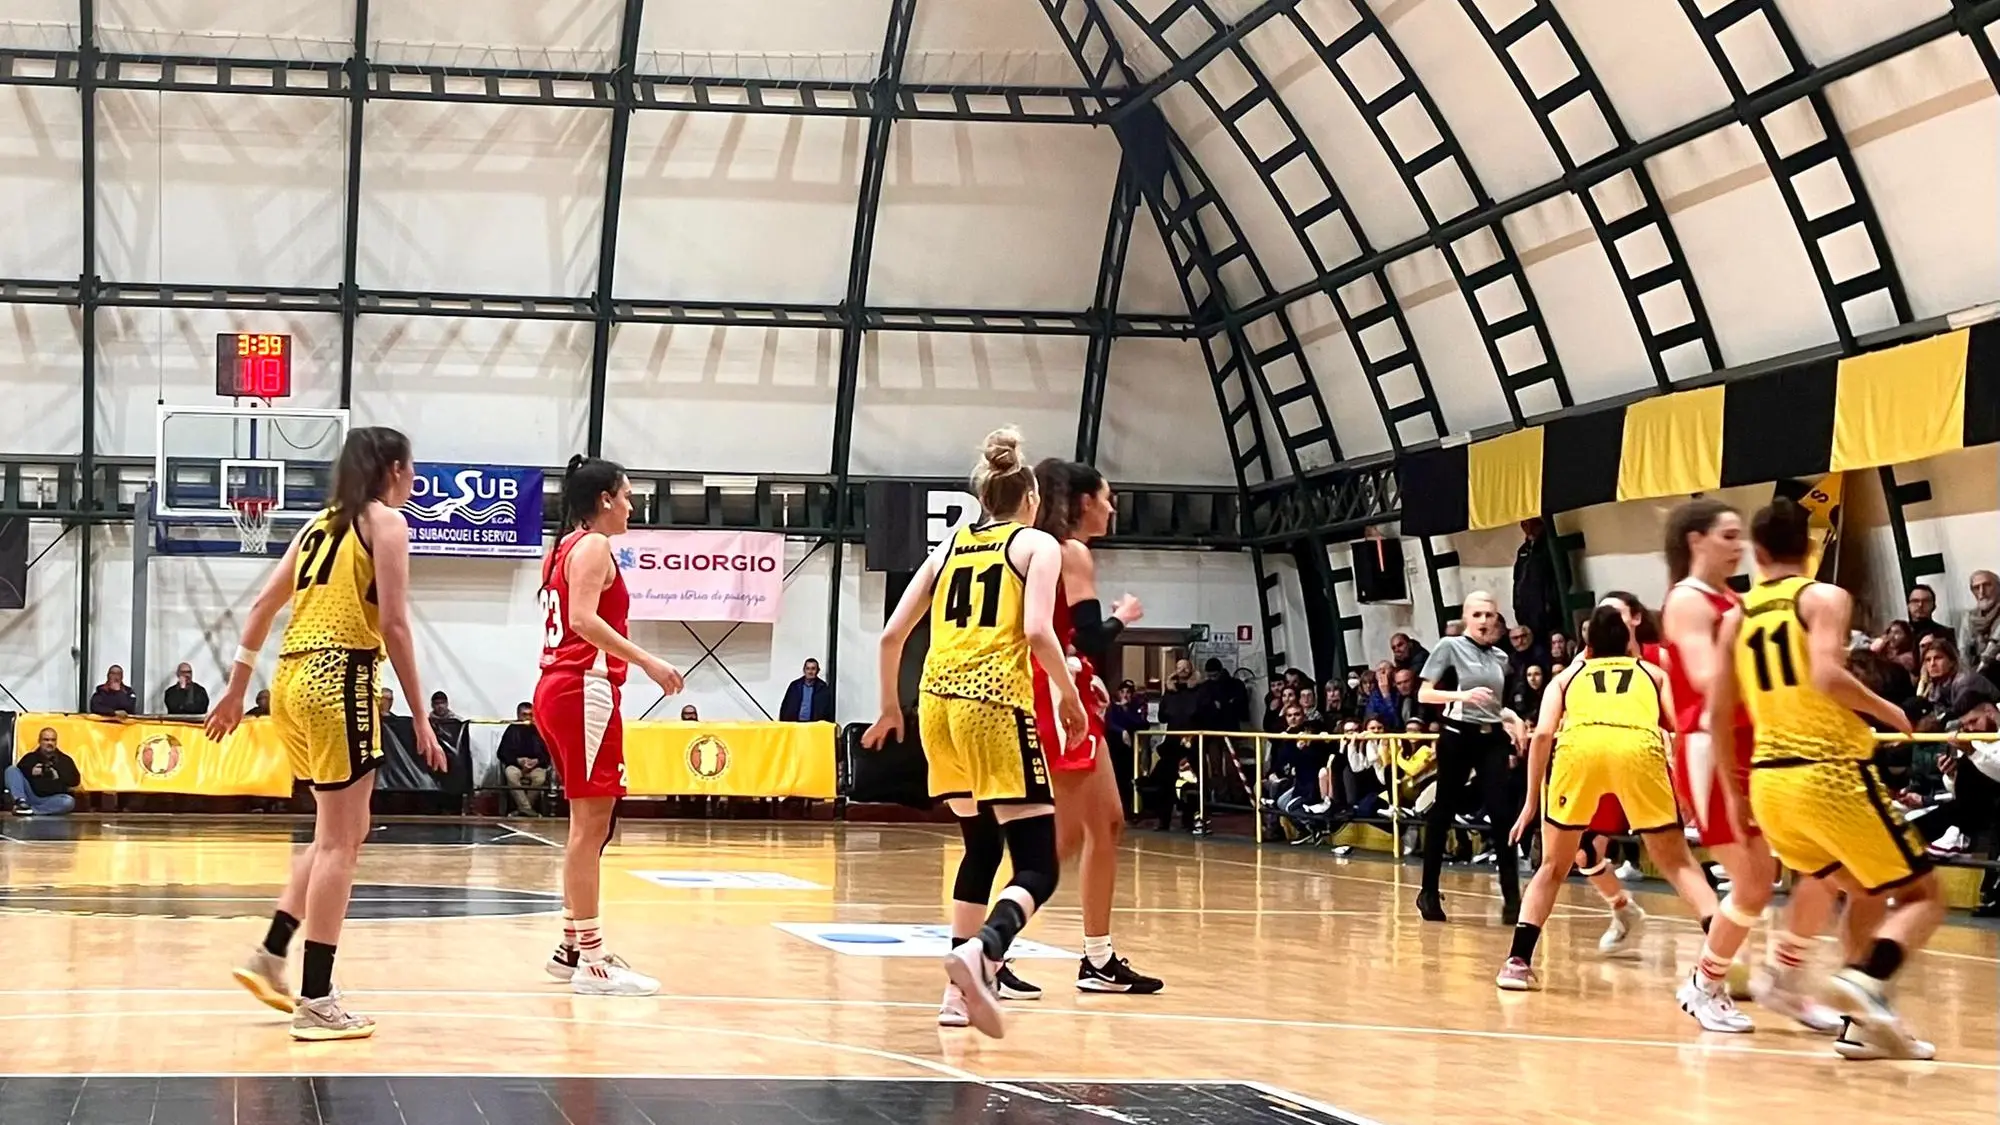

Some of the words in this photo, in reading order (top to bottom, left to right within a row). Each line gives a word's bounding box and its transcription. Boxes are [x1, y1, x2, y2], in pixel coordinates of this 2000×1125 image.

[238, 334, 281, 355] 3:39
[419, 527, 472, 542] SUBACQUEI
[473, 529, 480, 542] E
[482, 529, 518, 543] SERVIZI
[639, 553, 776, 573] S.GIORGIO
[945, 563, 1004, 628] 41
[1746, 620, 1799, 692] 11
[1585, 668, 1634, 694] 17
